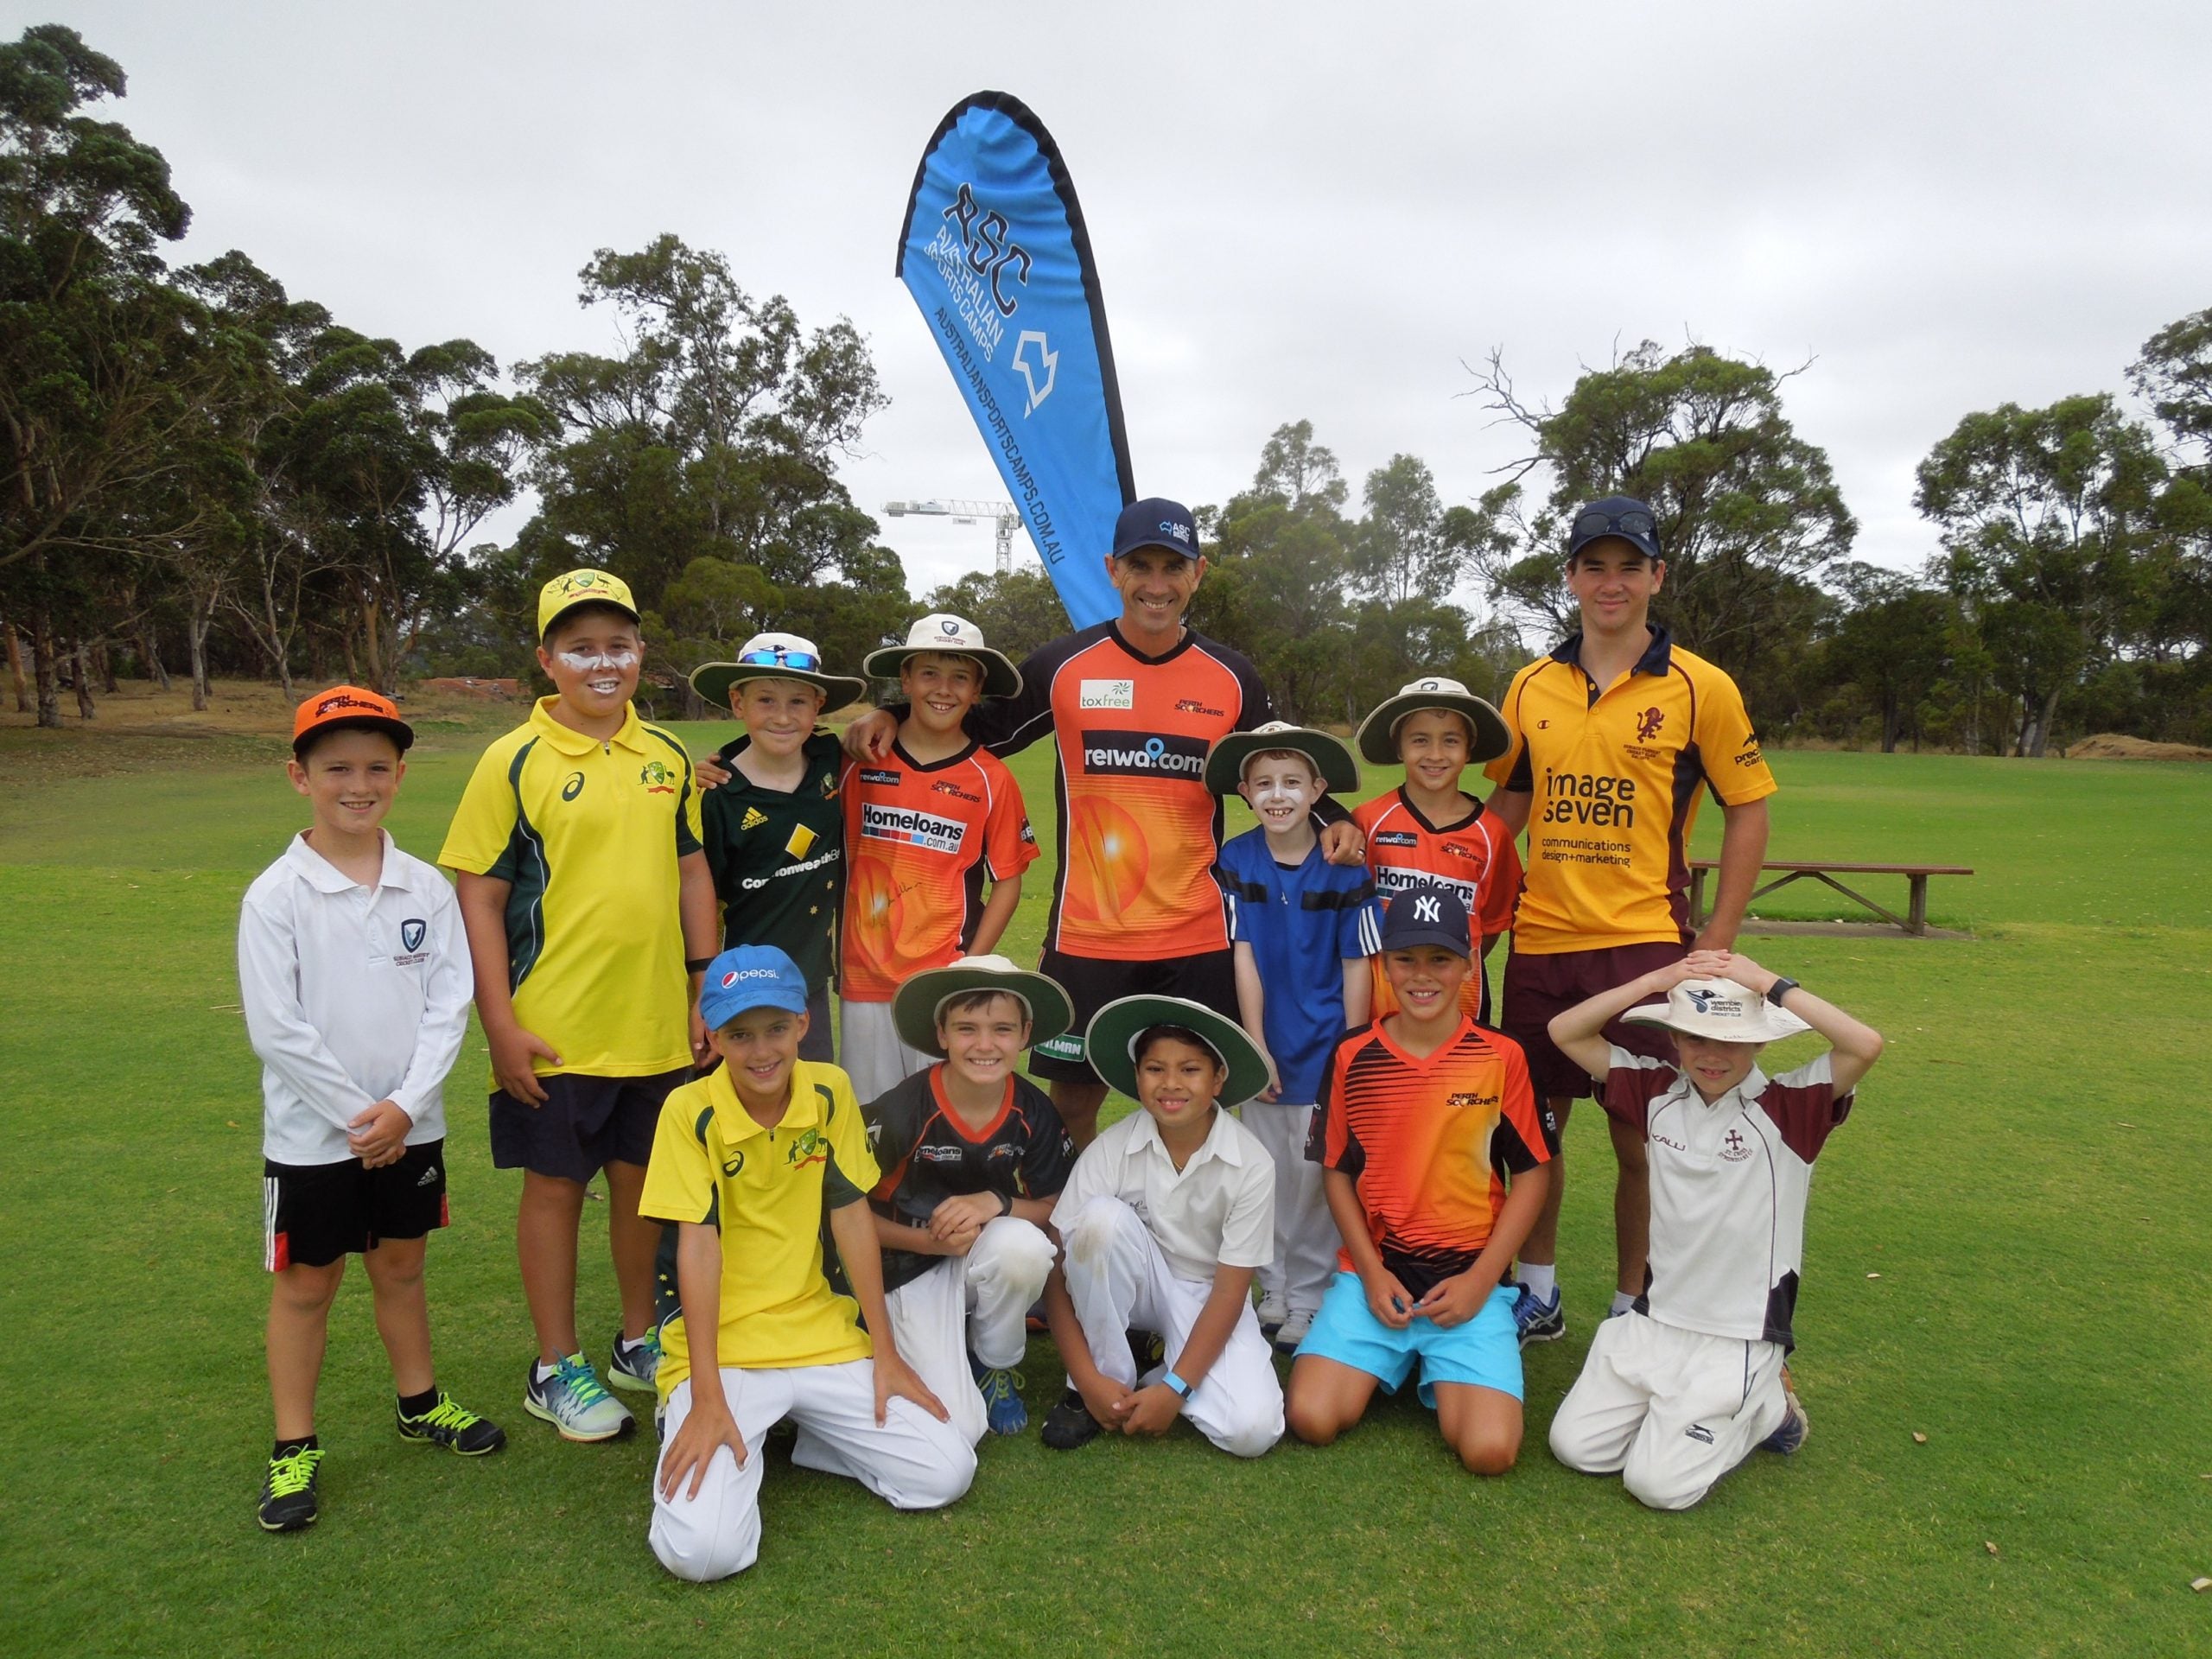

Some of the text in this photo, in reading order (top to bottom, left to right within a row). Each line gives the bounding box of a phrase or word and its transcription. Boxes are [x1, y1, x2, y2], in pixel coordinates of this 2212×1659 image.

[942, 182, 1033, 318] ASC
[937, 225, 1004, 346] AUSTRALIAN
[924, 240, 994, 362] SPORTS CAMPS
[934, 306, 1065, 565] AUSTRALIANSPORTSCAMPS.COM.AU
[1173, 522, 1191, 537] ASC
[1082, 695, 1130, 707] toxfree
[1175, 703, 1224, 716] SCORCHERS
[1084, 748, 1205, 773] reiwa.com
[931, 784, 982, 803] SCORCHERS
[936, 780, 960, 791] PERTH
[1546, 767, 1636, 806] image
[741, 815, 768, 830] adidas
[863, 804, 963, 841] Homeloans
[1543, 799, 1634, 828] seven
[923, 837, 959, 852] .com.au
[1541, 838, 1631, 853] communications
[1541, 850, 1631, 868] design+marketing
[1413, 895, 1441, 922] NY
[740, 969, 777, 982] pepsi
[1446, 1096, 1499, 1107] SCORCHERS
